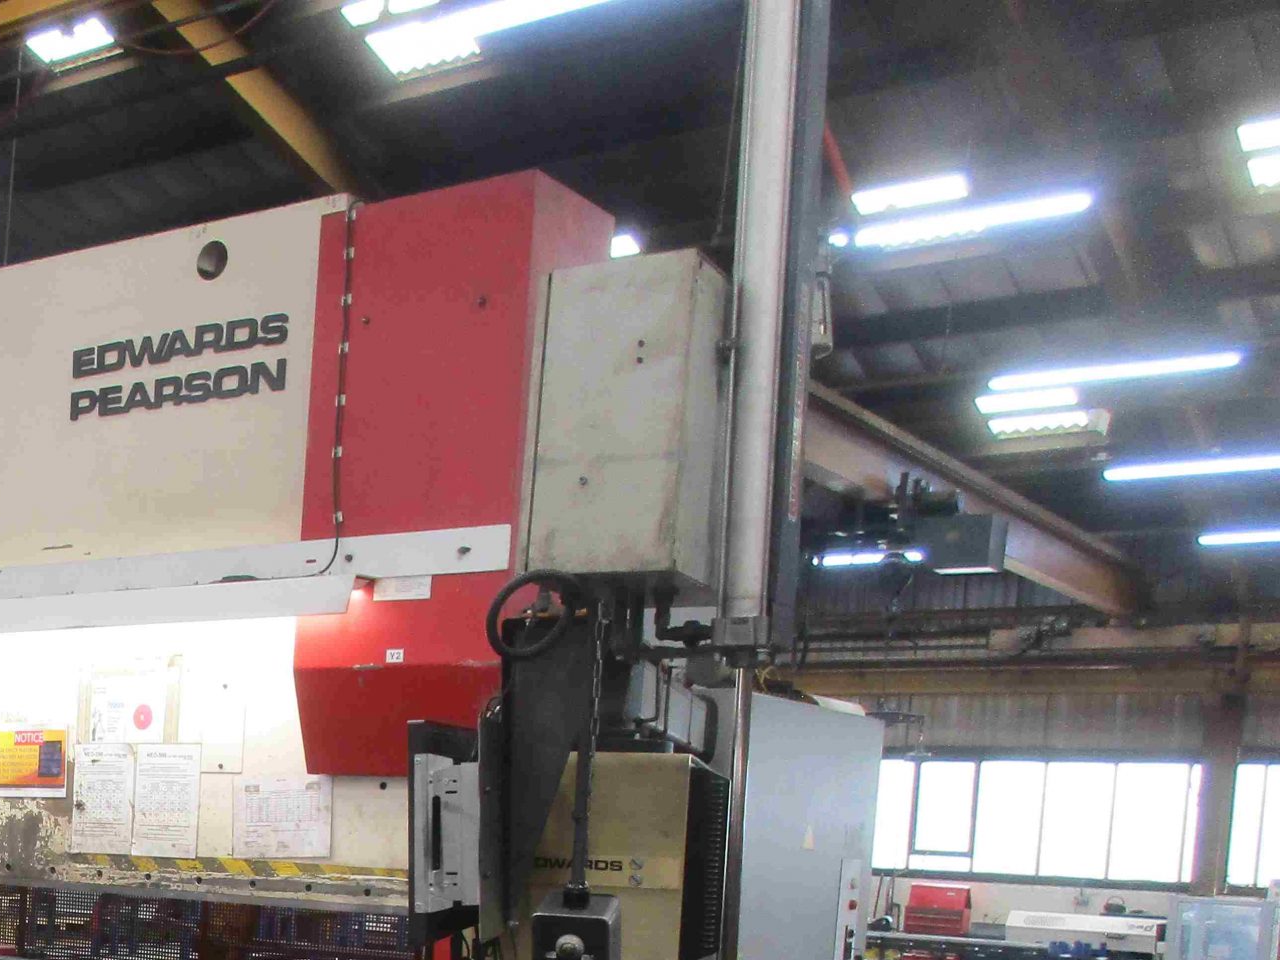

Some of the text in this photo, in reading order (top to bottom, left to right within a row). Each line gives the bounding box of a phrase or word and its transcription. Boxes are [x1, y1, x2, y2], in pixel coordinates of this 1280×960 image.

[72, 313, 289, 379] EDWARDS
[69, 358, 287, 421] PEARSON
[390, 651, 402, 660] Y2
[15, 732, 44, 743] NOTICE
[534, 857, 623, 872] DWRDS
